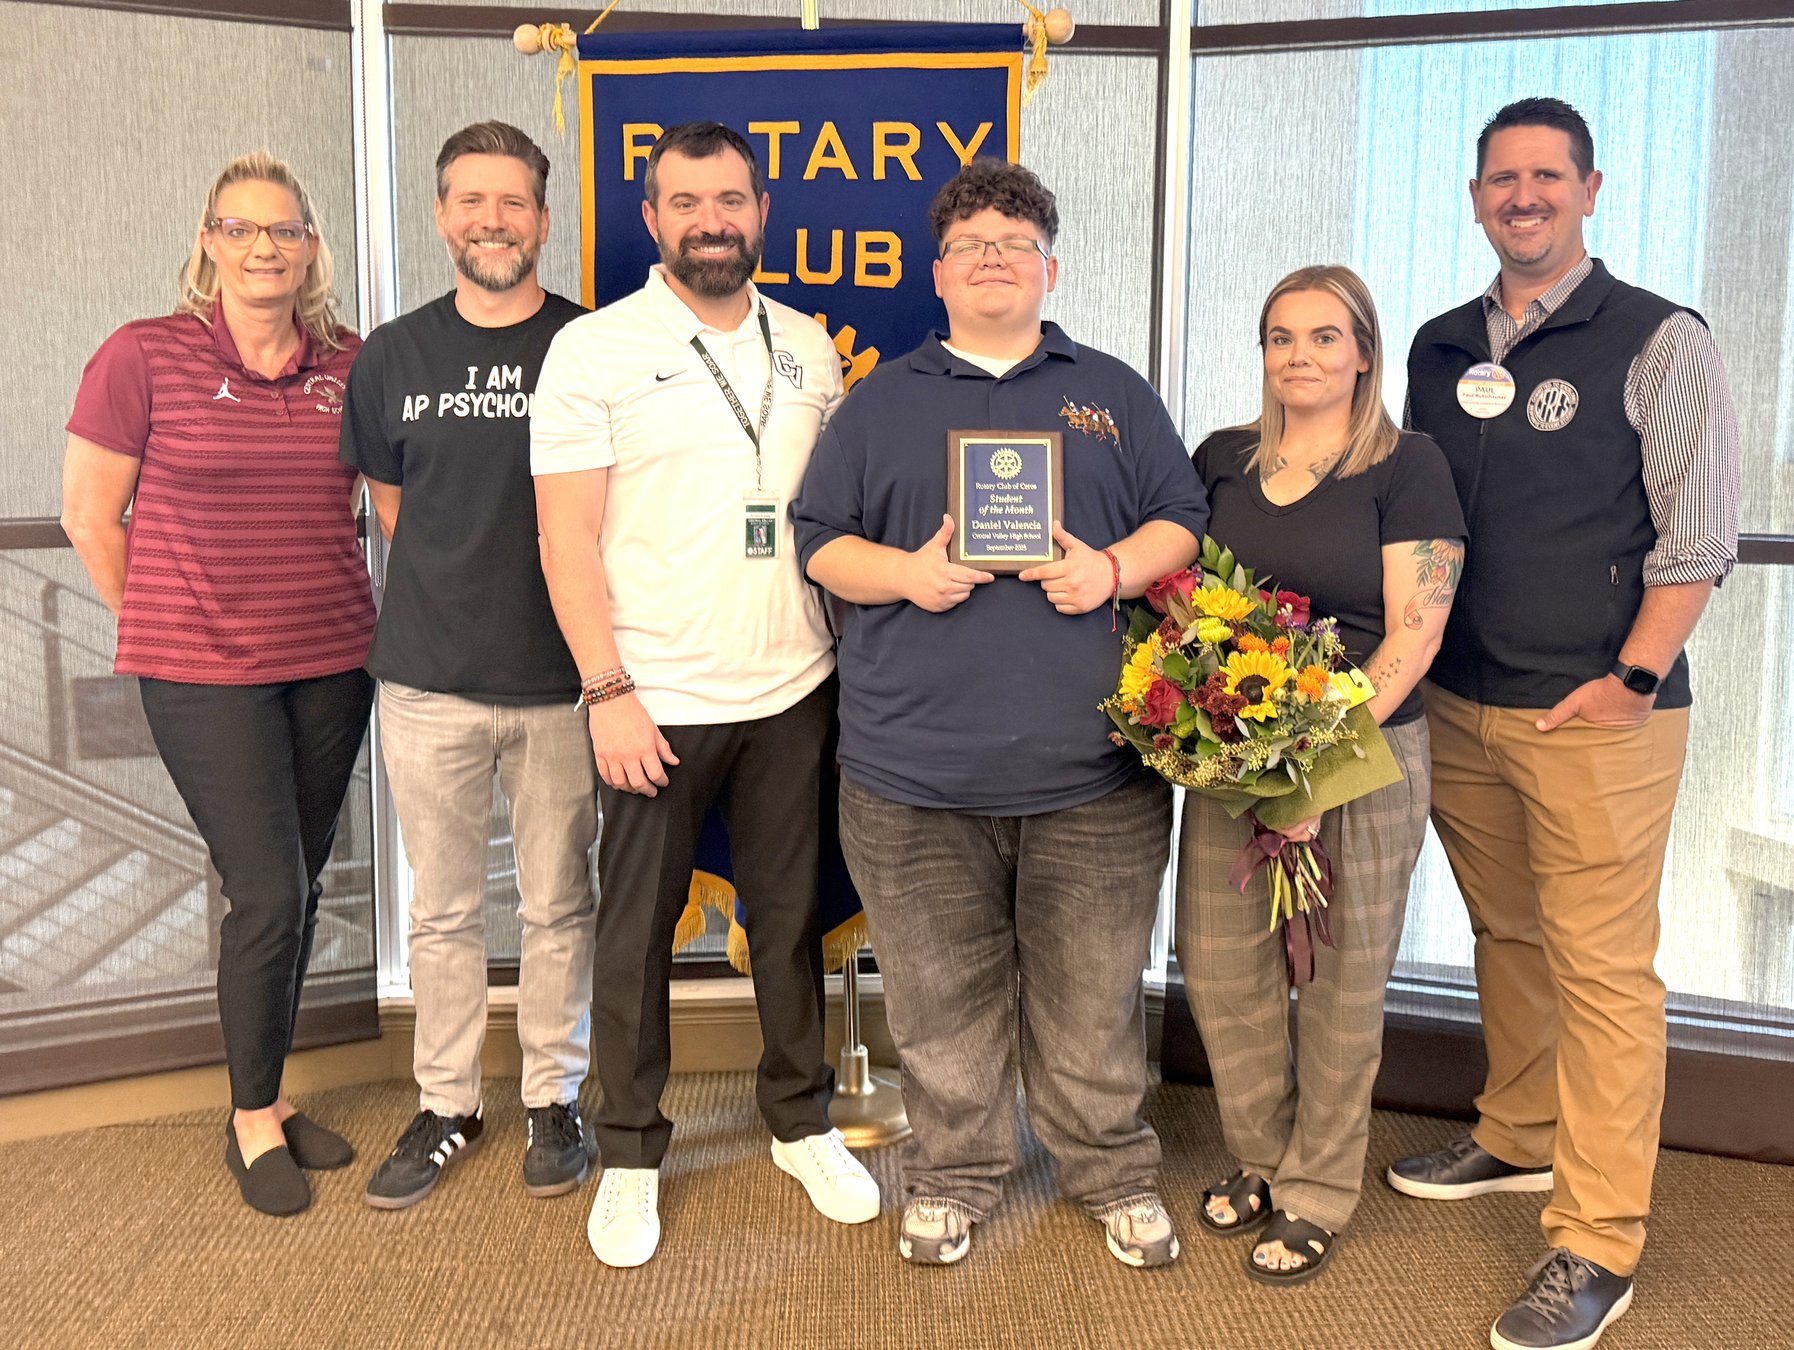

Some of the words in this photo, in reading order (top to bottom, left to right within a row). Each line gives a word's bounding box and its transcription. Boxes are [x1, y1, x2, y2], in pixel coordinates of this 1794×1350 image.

[623, 121, 993, 181] RTARY
[751, 228, 903, 288] LUB
[465, 366, 479, 390] I
[485, 364, 523, 390] AM
[1468, 368, 1491, 378] Rotary
[1475, 386, 1495, 394] PAUL
[402, 394, 430, 422] AP
[723, 386, 751, 428] TOGETHER
[975, 482, 996, 491] Rotary
[996, 482, 1012, 490] Club
[1012, 482, 1019, 490] of
[1020, 482, 1037, 490] Ceres
[989, 493, 1023, 503] Student
[978, 504, 989, 516] of
[990, 505, 1004, 515] the
[1004, 504, 1034, 515] Month
[971, 520, 1001, 530] Daniel
[1003, 520, 1042, 530] Valencia
[971, 532, 991, 540] Central
[991, 532, 1009, 541] Valley
[1009, 532, 1023, 541] High
[1023, 532, 1042, 540] School
[753, 547, 773, 555] STAFF
[986, 544, 1015, 553] September
